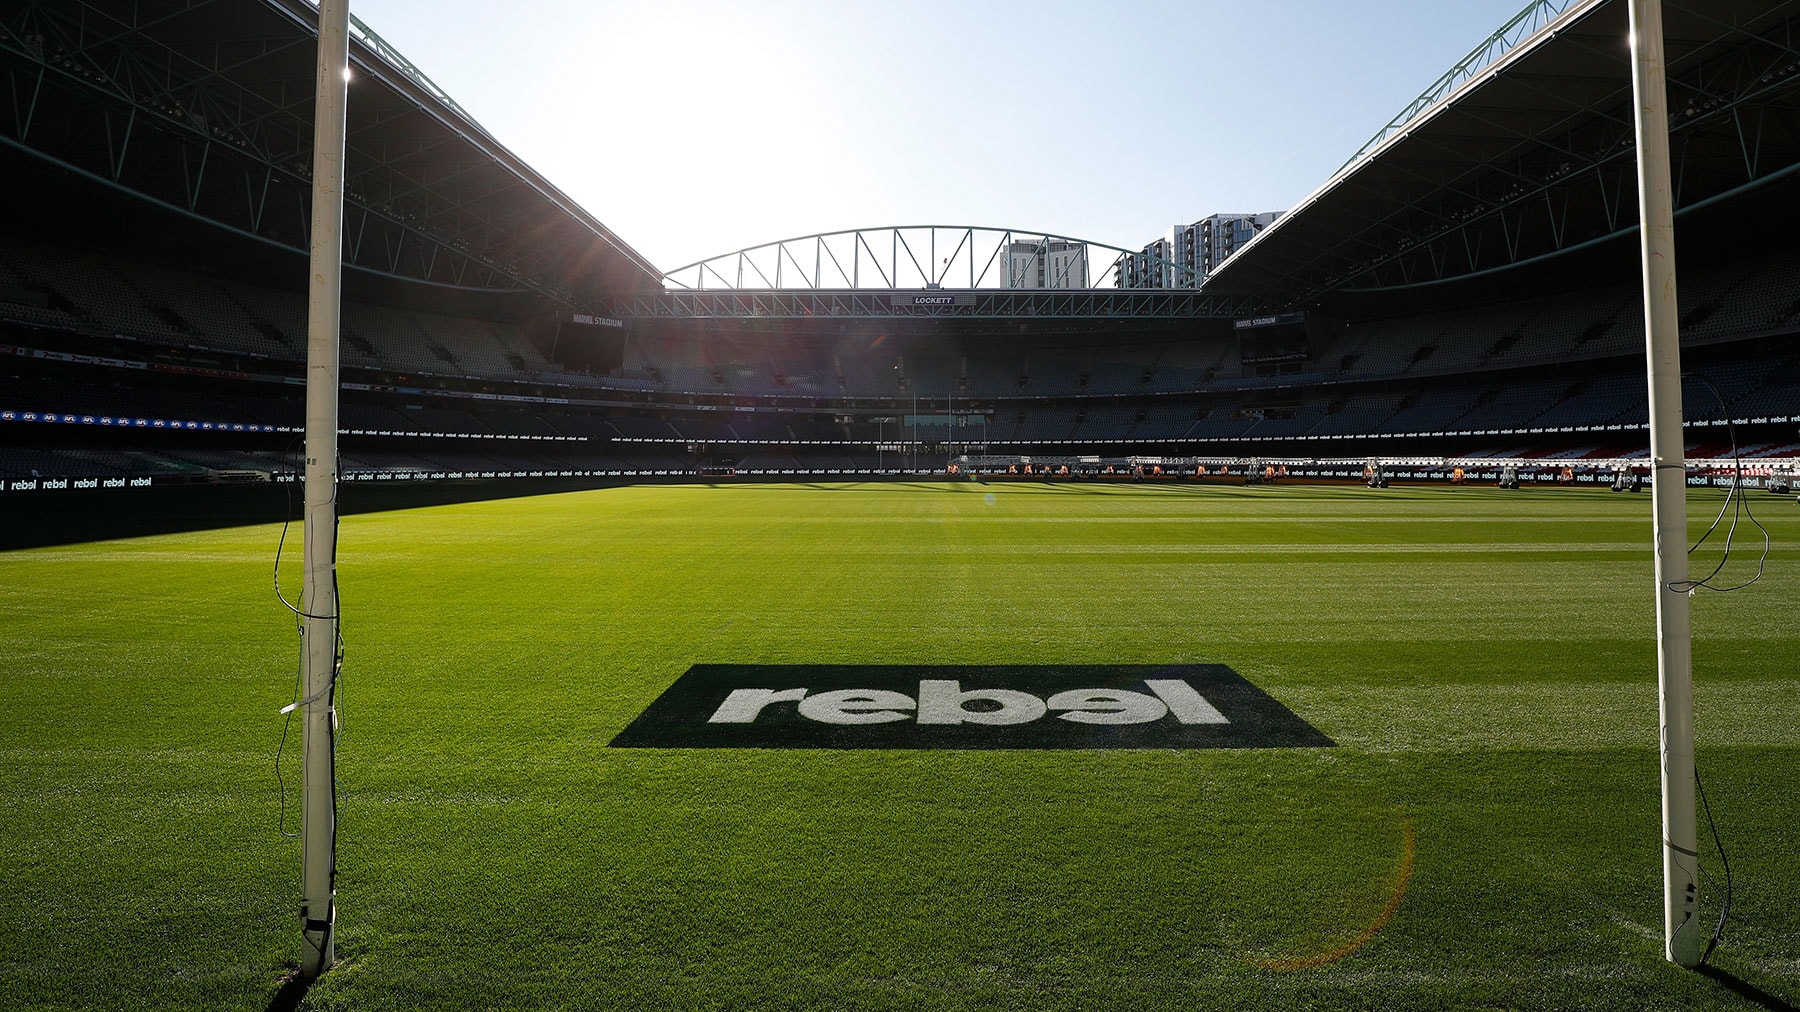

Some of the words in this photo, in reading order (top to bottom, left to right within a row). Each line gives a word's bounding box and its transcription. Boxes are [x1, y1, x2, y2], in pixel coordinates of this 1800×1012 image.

[573, 313, 593, 325] MARVEL
[594, 317, 623, 328] STADIUM
[1252, 317, 1276, 326] STADIUM
[1693, 419, 1708, 427] rebel
[1712, 418, 1728, 426] rebel
[1732, 417, 1748, 425] rebel
[1752, 416, 1767, 424] rebel
[1771, 415, 1787, 423] rebel
[12, 480, 36, 490] rebel
[43, 479, 67, 488] rebel
[74, 479, 97, 488] rebel
[104, 478, 125, 487] rebel
[131, 477, 151, 486] rebel
[1688, 476, 1707, 485] rebel
[707, 679, 1231, 725] rebel
